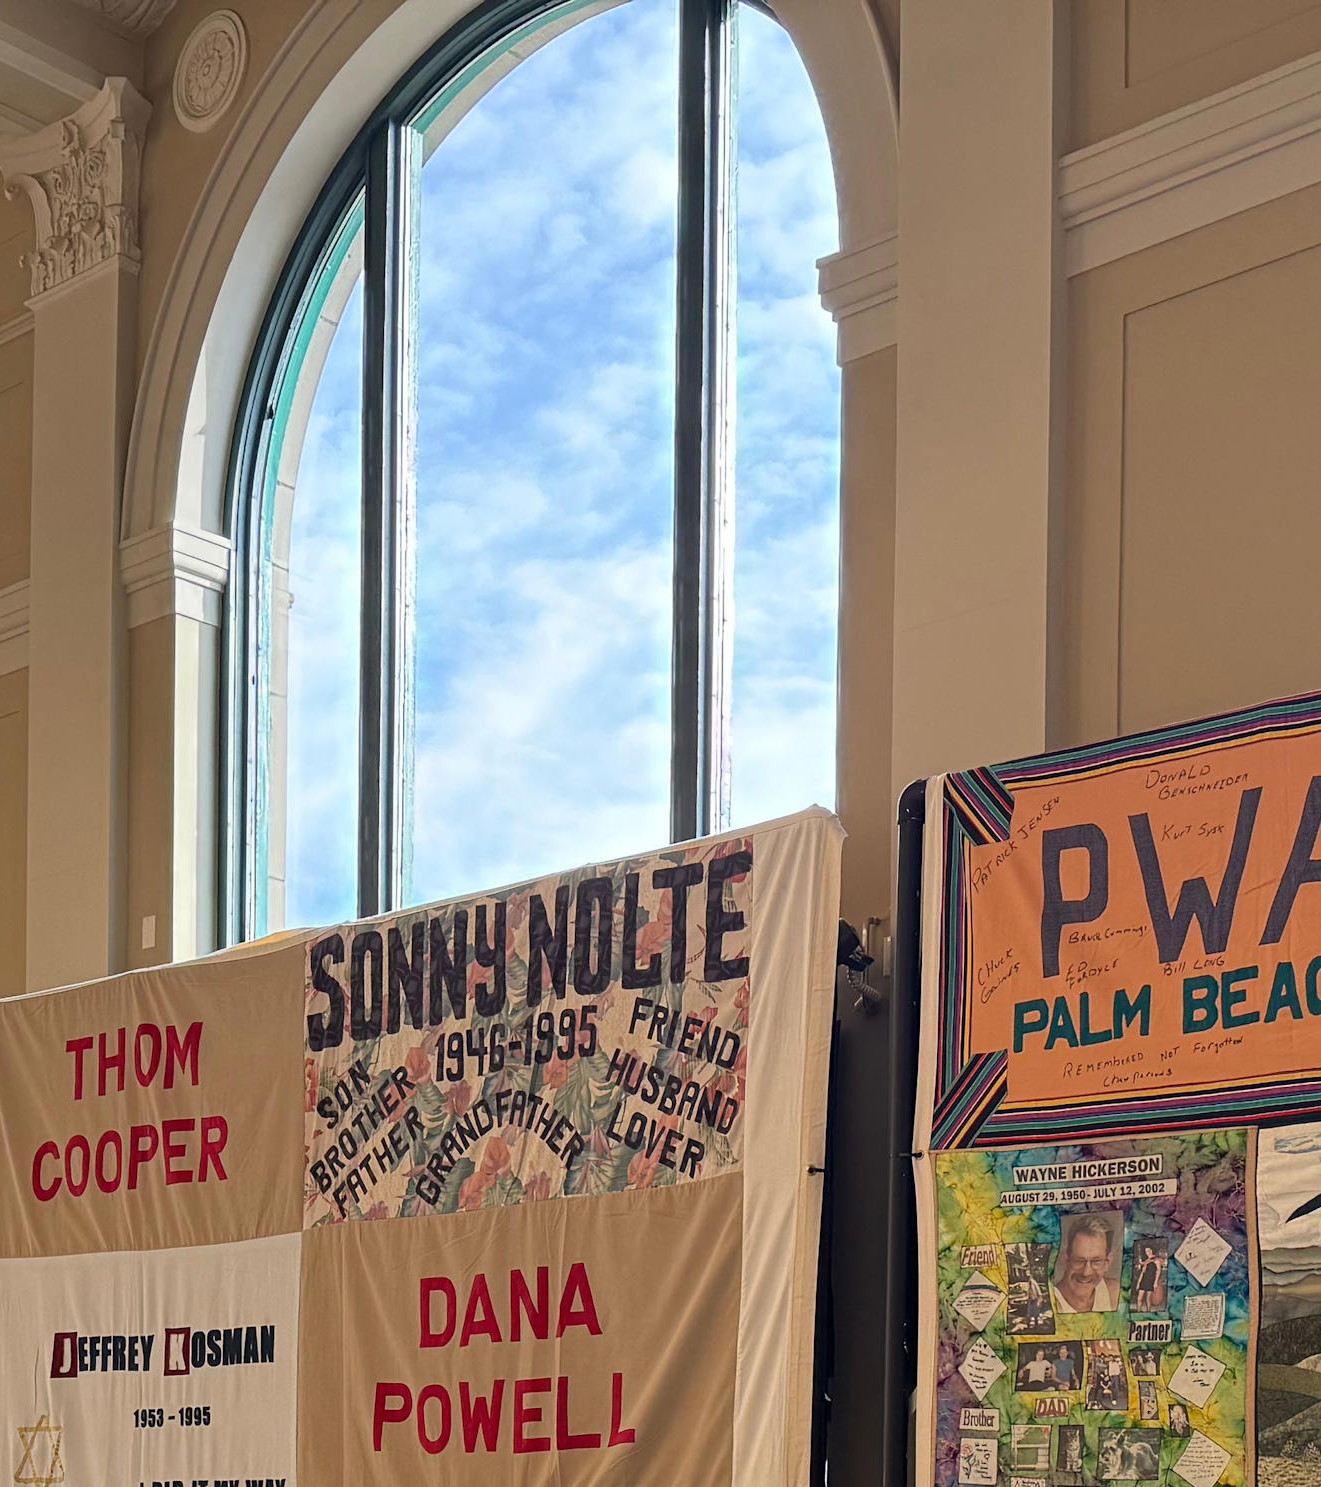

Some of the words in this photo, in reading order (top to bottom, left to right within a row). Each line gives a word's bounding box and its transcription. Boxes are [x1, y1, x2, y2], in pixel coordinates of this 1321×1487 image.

[306, 901, 508, 1053] SONNY
[525, 851, 754, 1007] NOLTE
[435, 1005, 599, 1083] 1946-1995
[628, 997, 742, 1070] FRIEND
[1012, 984, 1151, 1053] PALM
[64, 1020, 204, 1101] THOM
[316, 1059, 374, 1130] SON
[605, 1048, 739, 1135] HUSBAND
[31, 1114, 229, 1202] COOPER
[309, 1064, 417, 1194] BROTHER
[331, 1106, 426, 1219] FATHER
[416, 1089, 585, 1206] GRANDFATHER
[606, 1100, 706, 1178] LOVER
[1001, 1192, 1040, 1204] AUGUST
[1093, 1186, 1118, 1198] JULY
[1138, 1183, 1165, 1195] 2002
[1016, 1167, 1067, 1183] WAYNE
[1071, 1157, 1161, 1179] HICKERSON
[418, 1261, 603, 1349] DANA
[1129, 1321, 1171, 1341] Partner
[50, 1332, 155, 1378] JEFFREY
[164, 1325, 275, 1376] KOSMAN
[133, 1408, 164, 1428] 1953
[178, 1406, 211, 1427] 1995
[373, 1372, 635, 1454] POWELL
[962, 1410, 995, 1428] Brother
[1037, 1399, 1068, 1417] DAD
